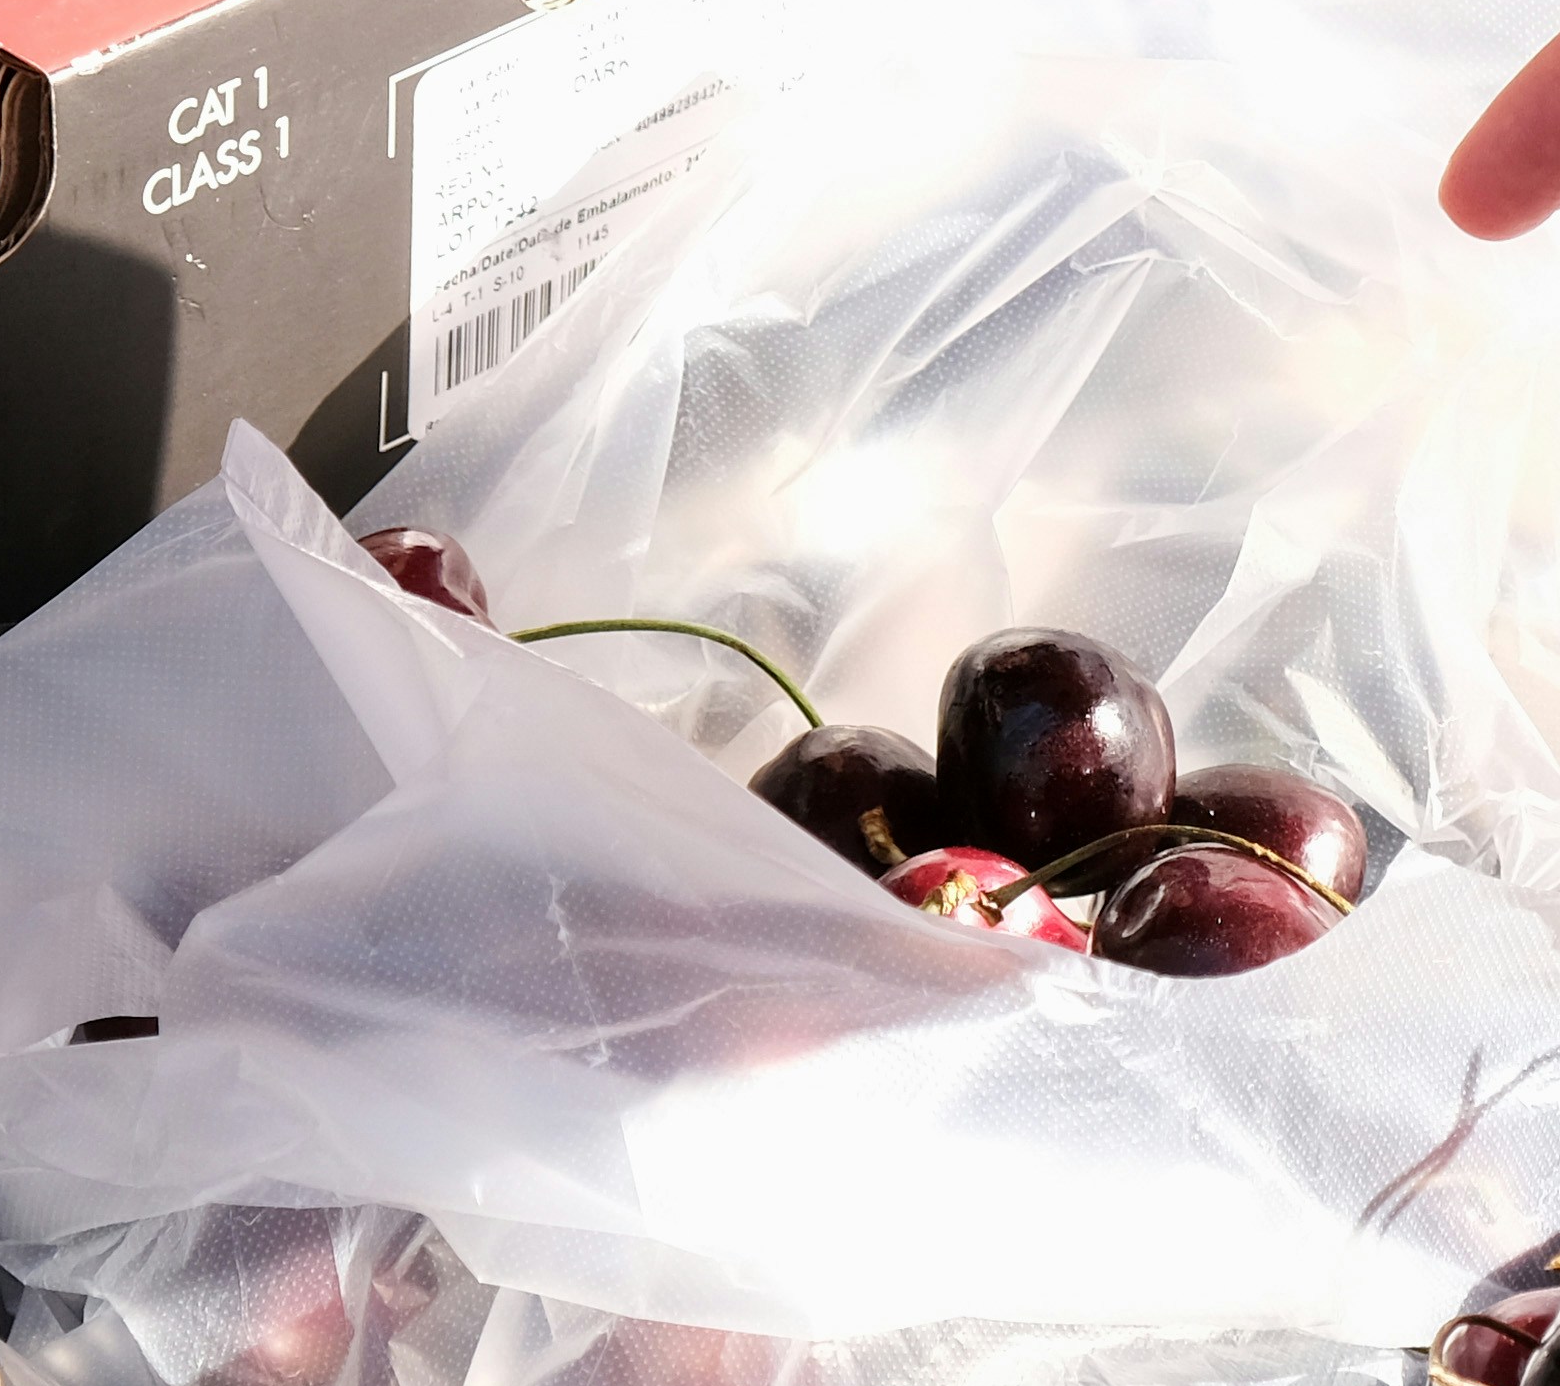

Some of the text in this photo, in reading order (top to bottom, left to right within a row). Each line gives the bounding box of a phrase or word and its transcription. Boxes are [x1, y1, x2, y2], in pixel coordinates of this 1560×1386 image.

[168, 65, 268, 144] CAT 1
[142, 115, 289, 215] CLASS 1
[493, 265, 525, 293] S-10
[578, 223, 610, 250] 1145
